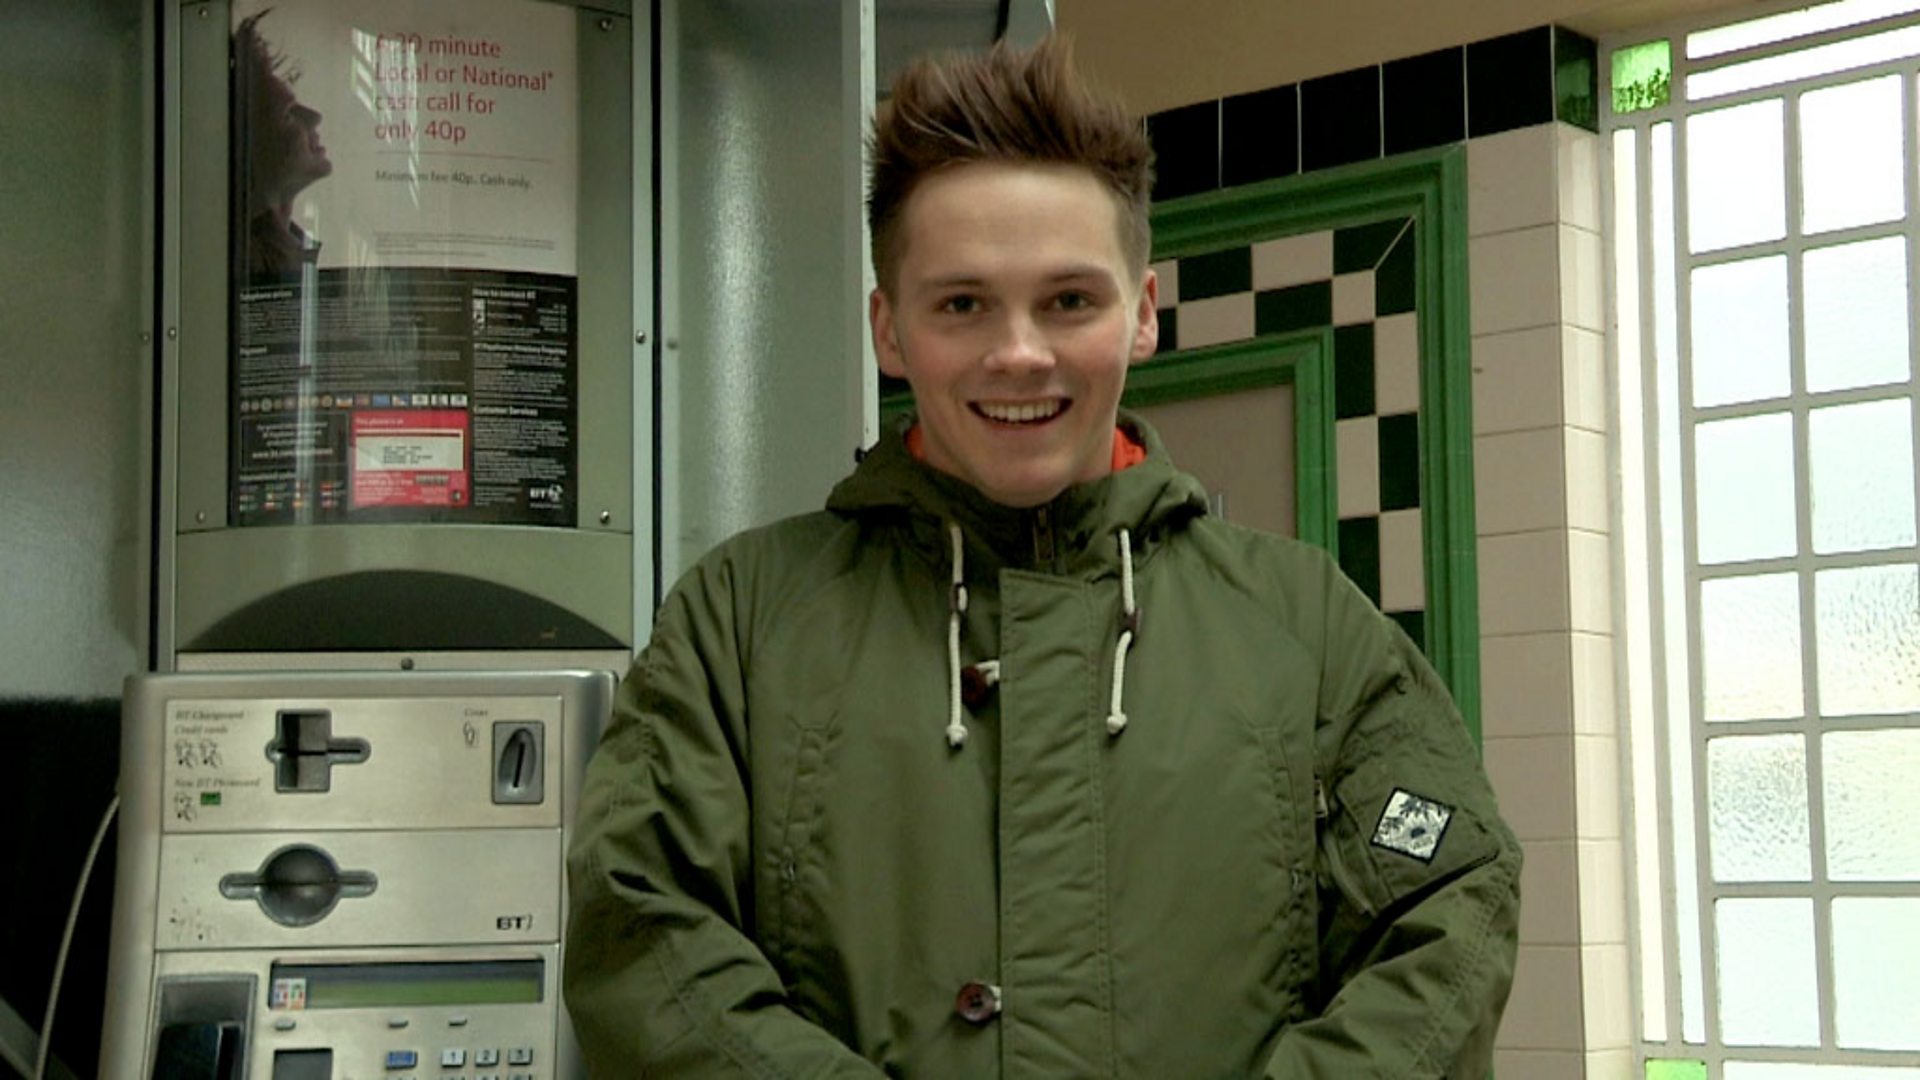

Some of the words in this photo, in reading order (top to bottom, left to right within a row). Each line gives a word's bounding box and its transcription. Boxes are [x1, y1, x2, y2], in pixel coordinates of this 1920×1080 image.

[427, 35, 502, 58] minute
[376, 62, 428, 83] Local
[435, 68, 456, 83] or
[426, 91, 460, 112] call
[466, 90, 497, 114] for
[424, 119, 467, 146] 40p
[496, 915, 526, 930] BT
